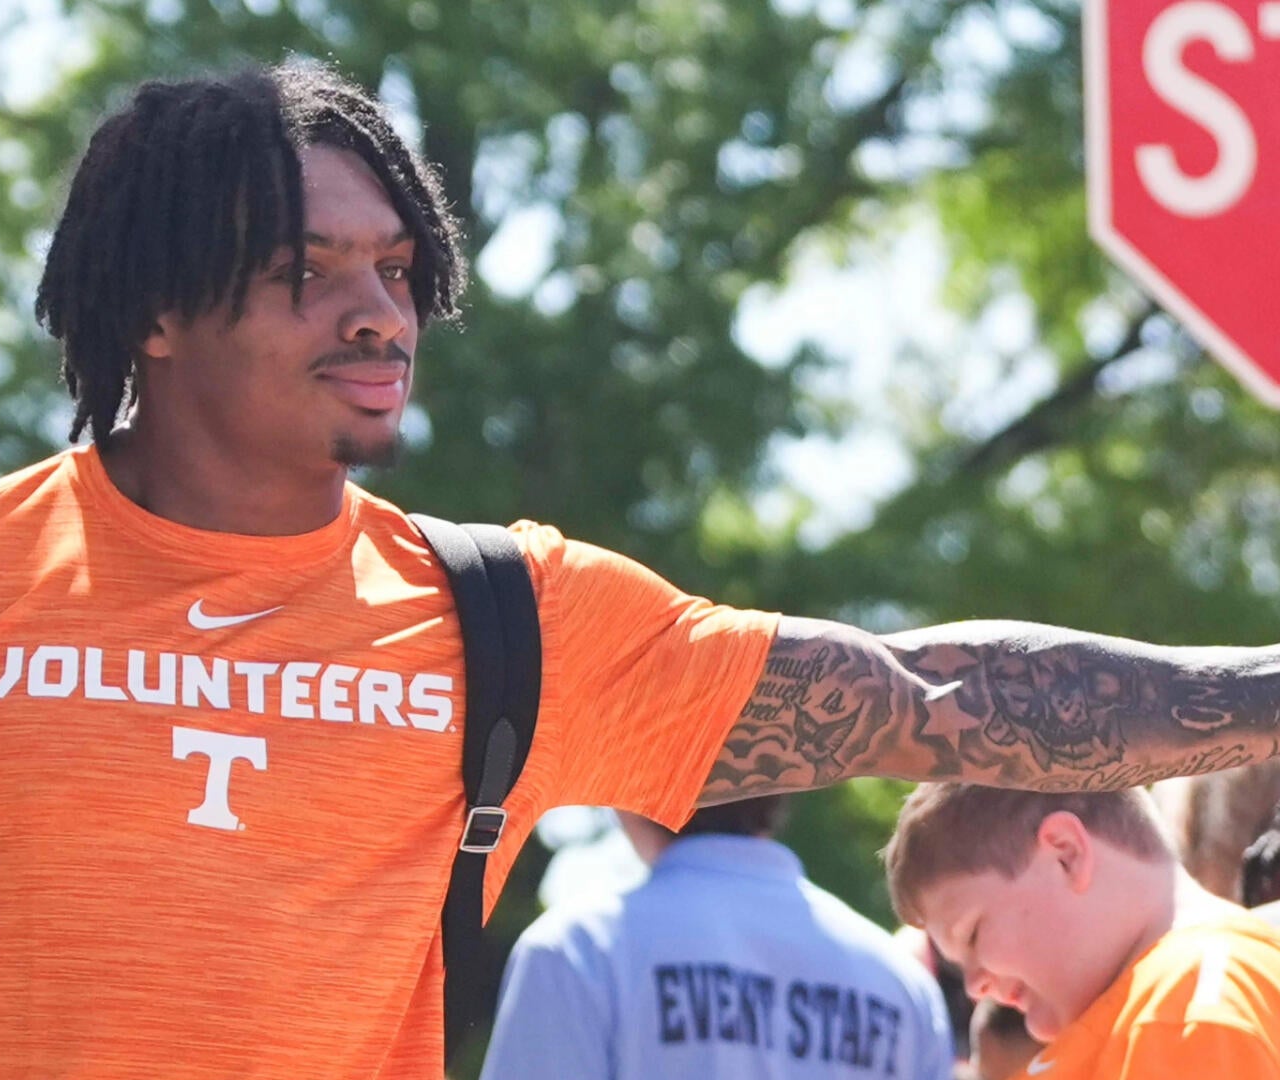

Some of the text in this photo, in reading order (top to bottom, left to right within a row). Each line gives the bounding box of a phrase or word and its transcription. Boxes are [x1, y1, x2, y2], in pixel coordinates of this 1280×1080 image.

[172, 726, 268, 831] T
[653, 963, 903, 1077] EVENT STAFF
